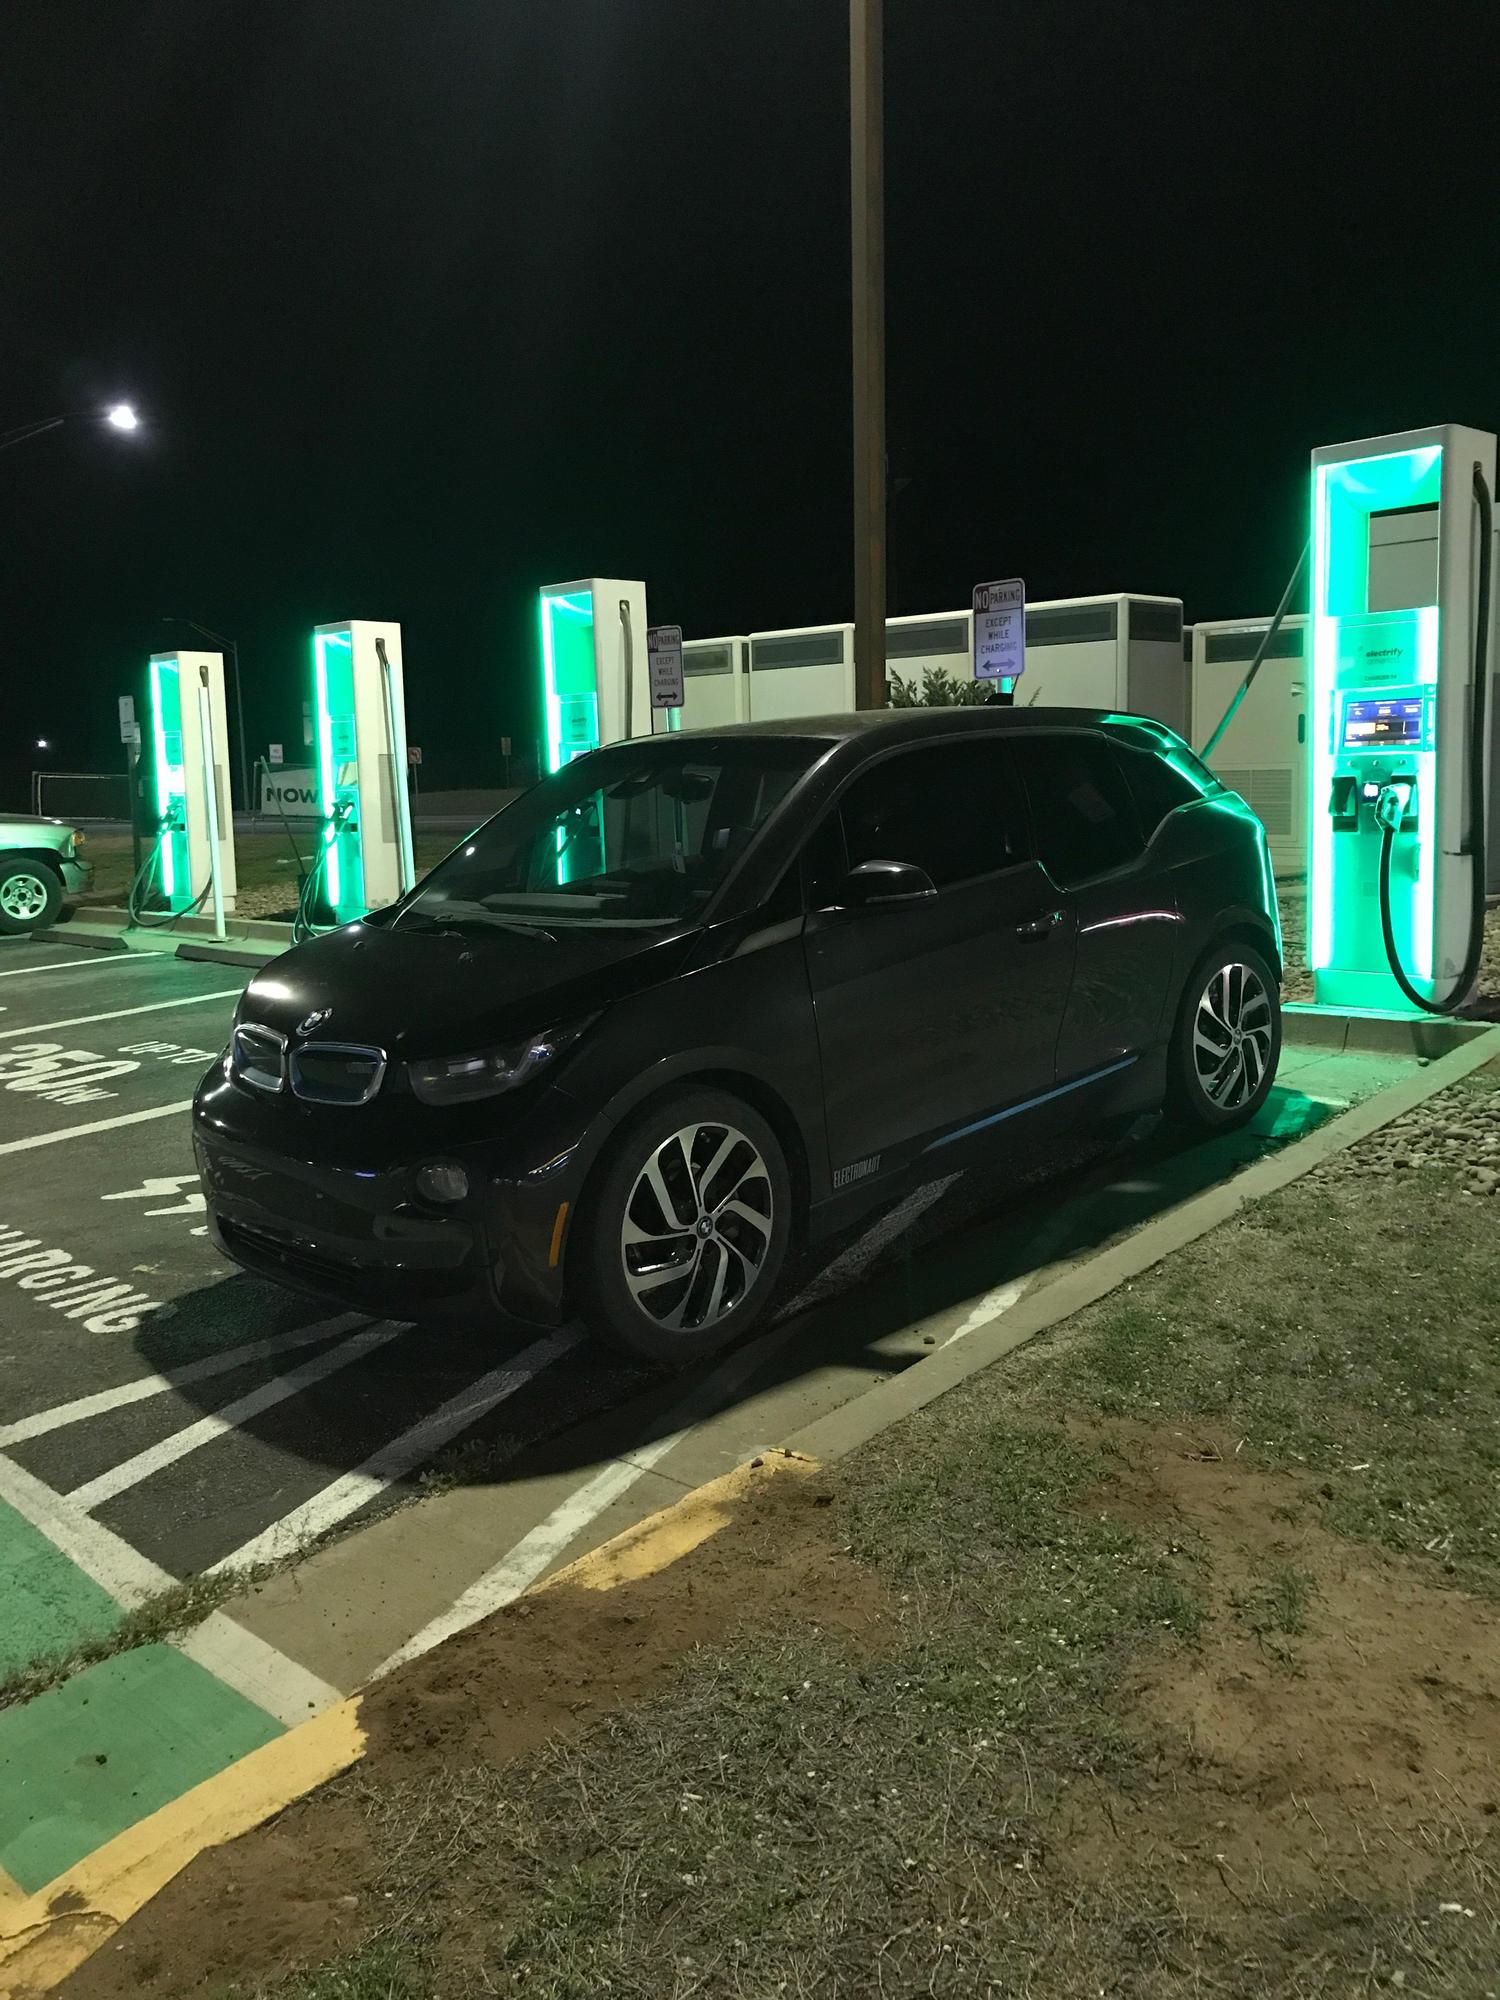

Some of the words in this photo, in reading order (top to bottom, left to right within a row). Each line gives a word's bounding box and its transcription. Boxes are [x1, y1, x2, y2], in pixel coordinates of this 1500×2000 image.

[975, 590, 989, 610] NO
[990, 589, 1019, 604] PARKING
[985, 616, 1012, 628] EXCEPT
[988, 629, 1009, 640] WHILE
[648, 633, 658, 650] NO
[658, 635, 679, 645] PARKING
[980, 641, 1017, 654] CHARGING
[1366, 648, 1403, 657] electrify
[656, 656, 674, 666] EXCEPT
[658, 667, 673, 676] WHILE
[654, 678, 679, 687] CHARGING
[266, 787, 319, 803] NOW
[118, 1041, 182, 1055] UP
[157, 1048, 219, 1064] TO
[833, 1154, 881, 1188] ELECTRONAUT
